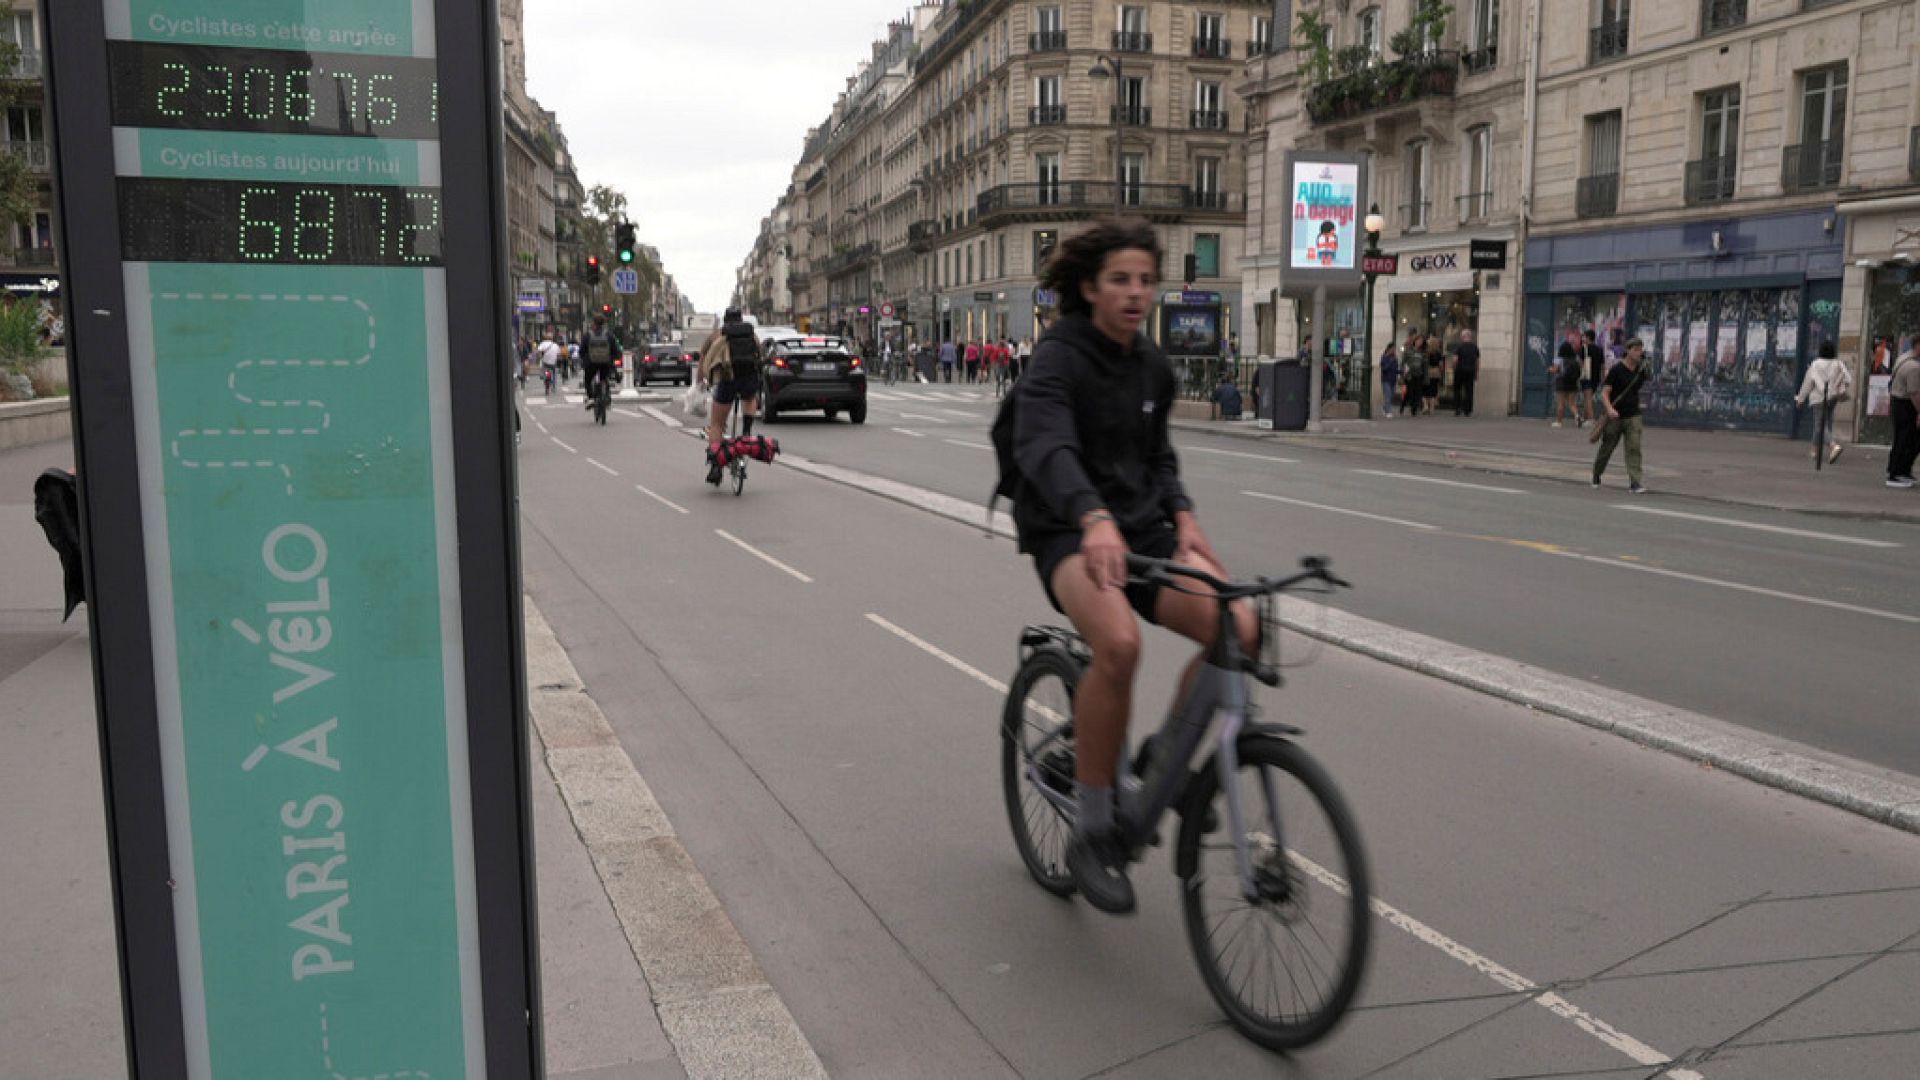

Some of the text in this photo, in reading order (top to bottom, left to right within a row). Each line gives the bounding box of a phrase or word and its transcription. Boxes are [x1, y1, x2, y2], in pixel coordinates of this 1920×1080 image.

[149, 13, 257, 39] Cyclistes
[263, 23, 321, 42] cette
[160, 147, 400, 175] Cyclistes aujourd'hui
[238, 188, 438, 261] 6872
[1363, 257, 1393, 271] ETRO
[1411, 253, 1457, 271] GEOX
[241, 717, 341, 771] À
[280, 793, 354, 980] PARIS
